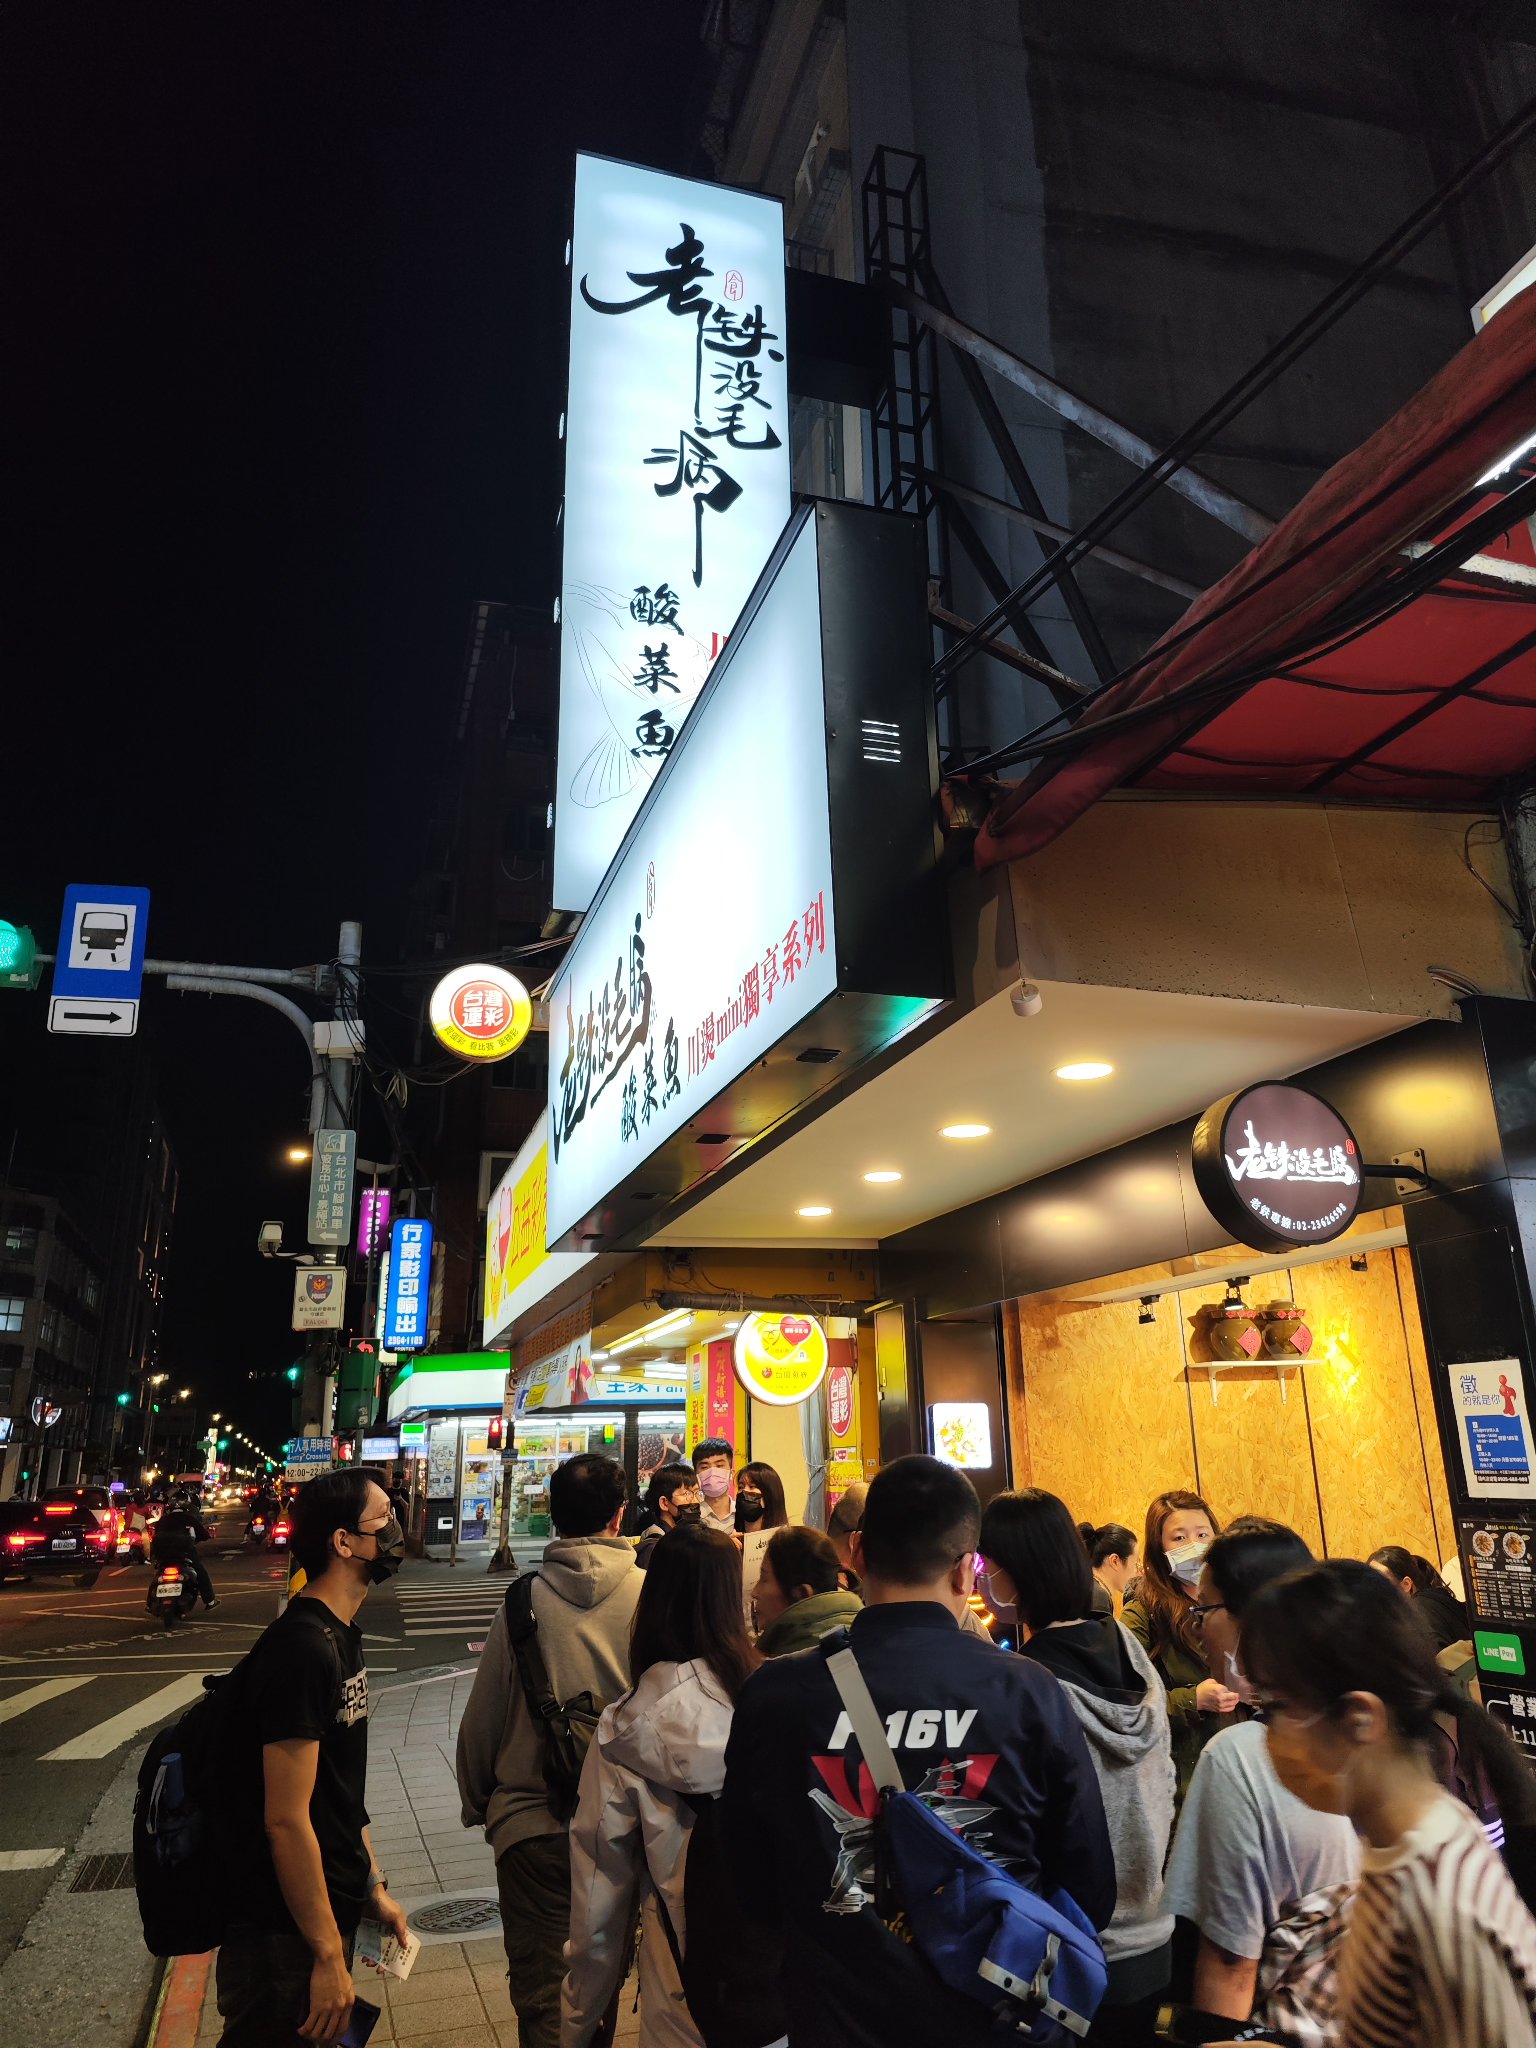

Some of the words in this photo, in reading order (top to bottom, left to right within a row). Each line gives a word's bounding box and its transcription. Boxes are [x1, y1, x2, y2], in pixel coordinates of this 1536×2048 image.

[630, 583, 684, 757] 酸菜魚
[462, 1006, 504, 1028] 運彩
[621, 1017, 681, 1143] 酸菜魚
[331, 1154, 347, 1229] 台北市腳踏車
[395, 1224, 423, 1333] 行家影印輸出
[1460, 1374, 1478, 1395] 徵
[1462, 1394, 1500, 1406] 的就是你
[306, 1453, 331, 1461] Crossing
[1483, 1647, 1500, 1657] LINE
[1502, 1649, 1514, 1659] Pay
